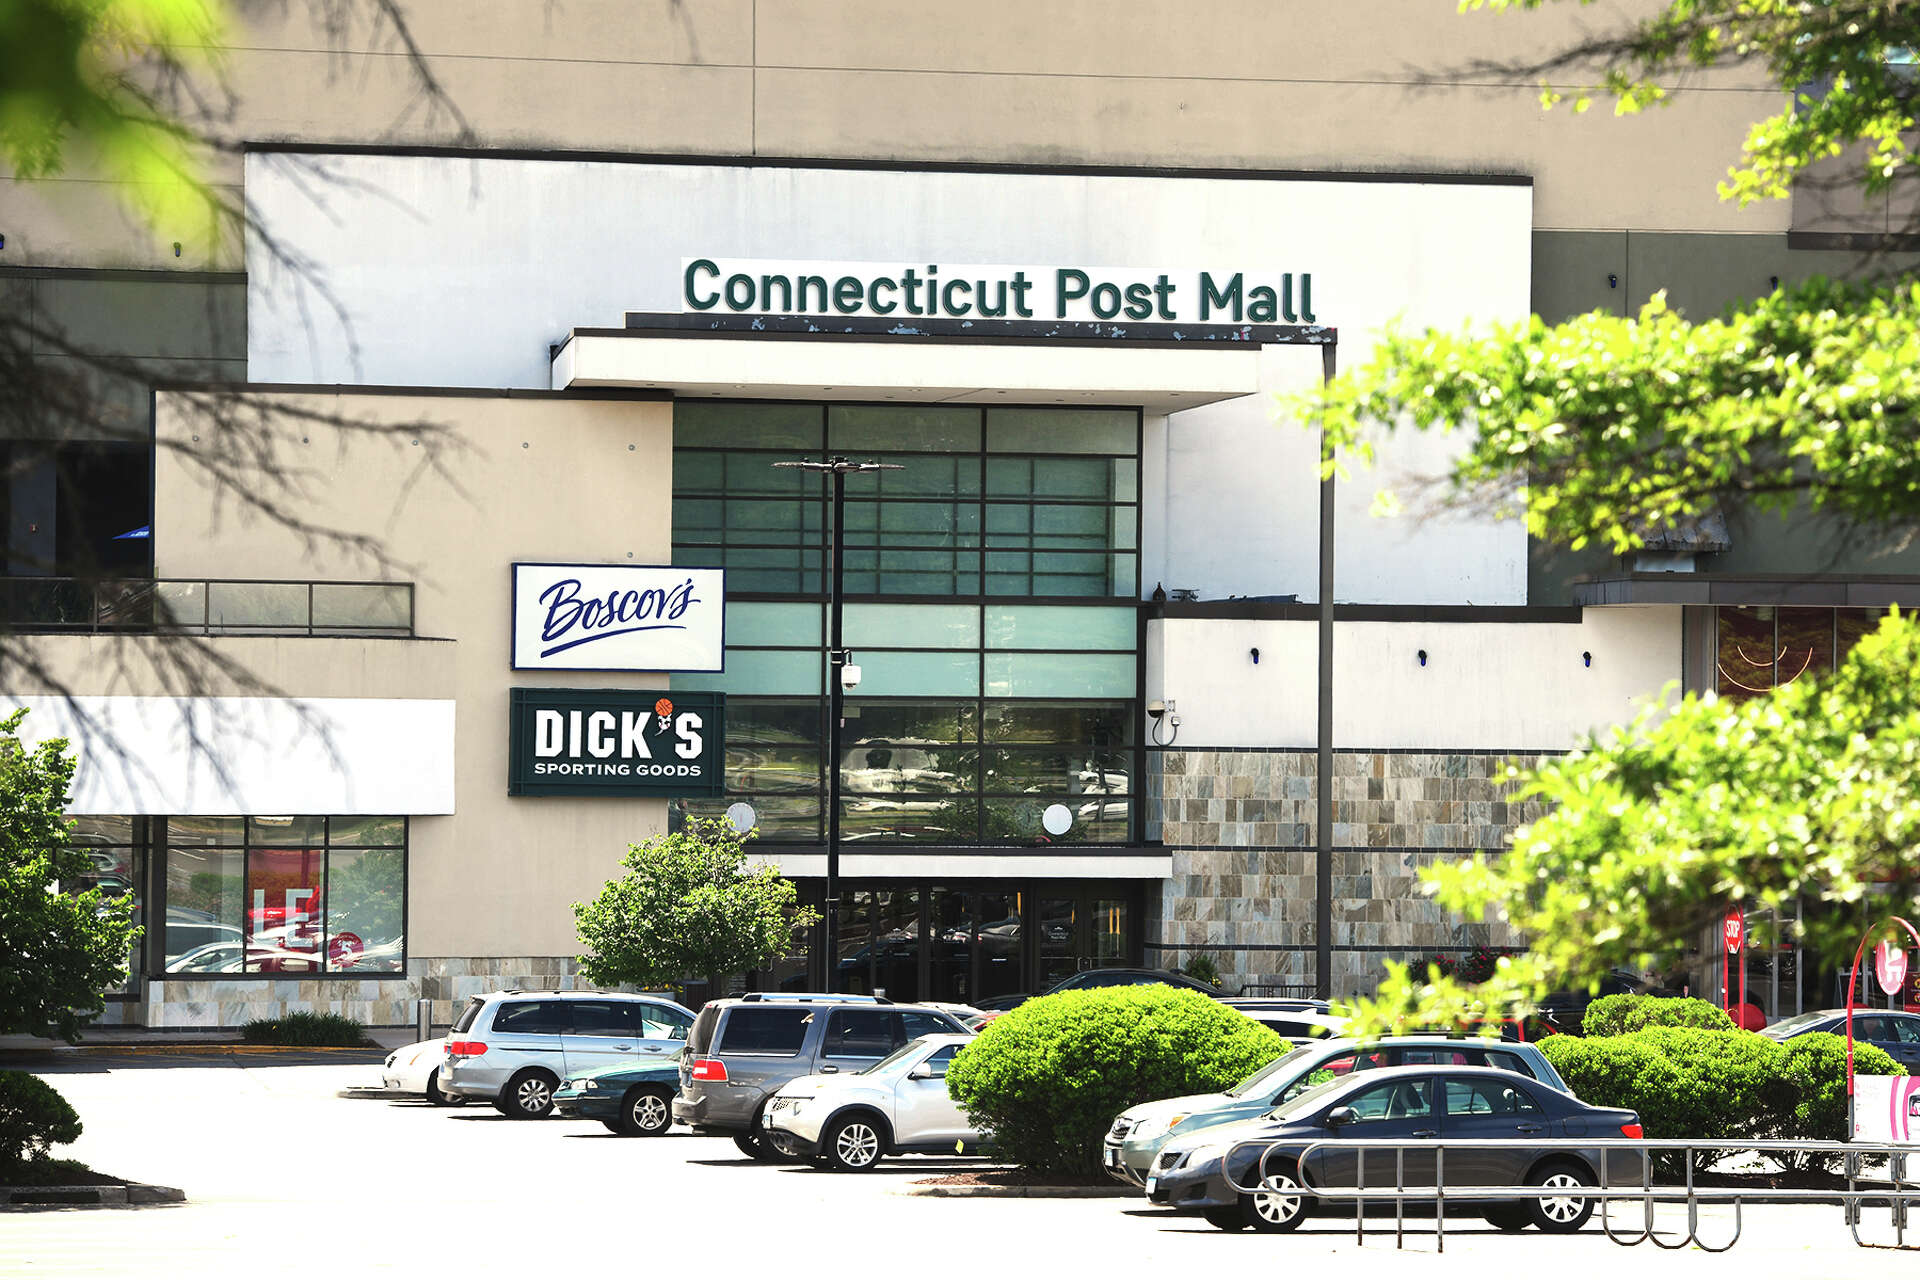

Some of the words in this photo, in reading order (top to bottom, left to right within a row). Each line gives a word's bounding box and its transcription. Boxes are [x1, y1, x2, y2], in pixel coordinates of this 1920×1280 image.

[685, 259, 1032, 318] Connecticut
[1056, 269, 1177, 321] Post
[1199, 272, 1316, 323] Mall
[538, 578, 702, 642] Boscov's
[535, 702, 704, 759] DICK'S
[534, 763, 630, 776] SPORTING
[636, 764, 702, 777] GOODS
[1726, 919, 1741, 938] STOP
